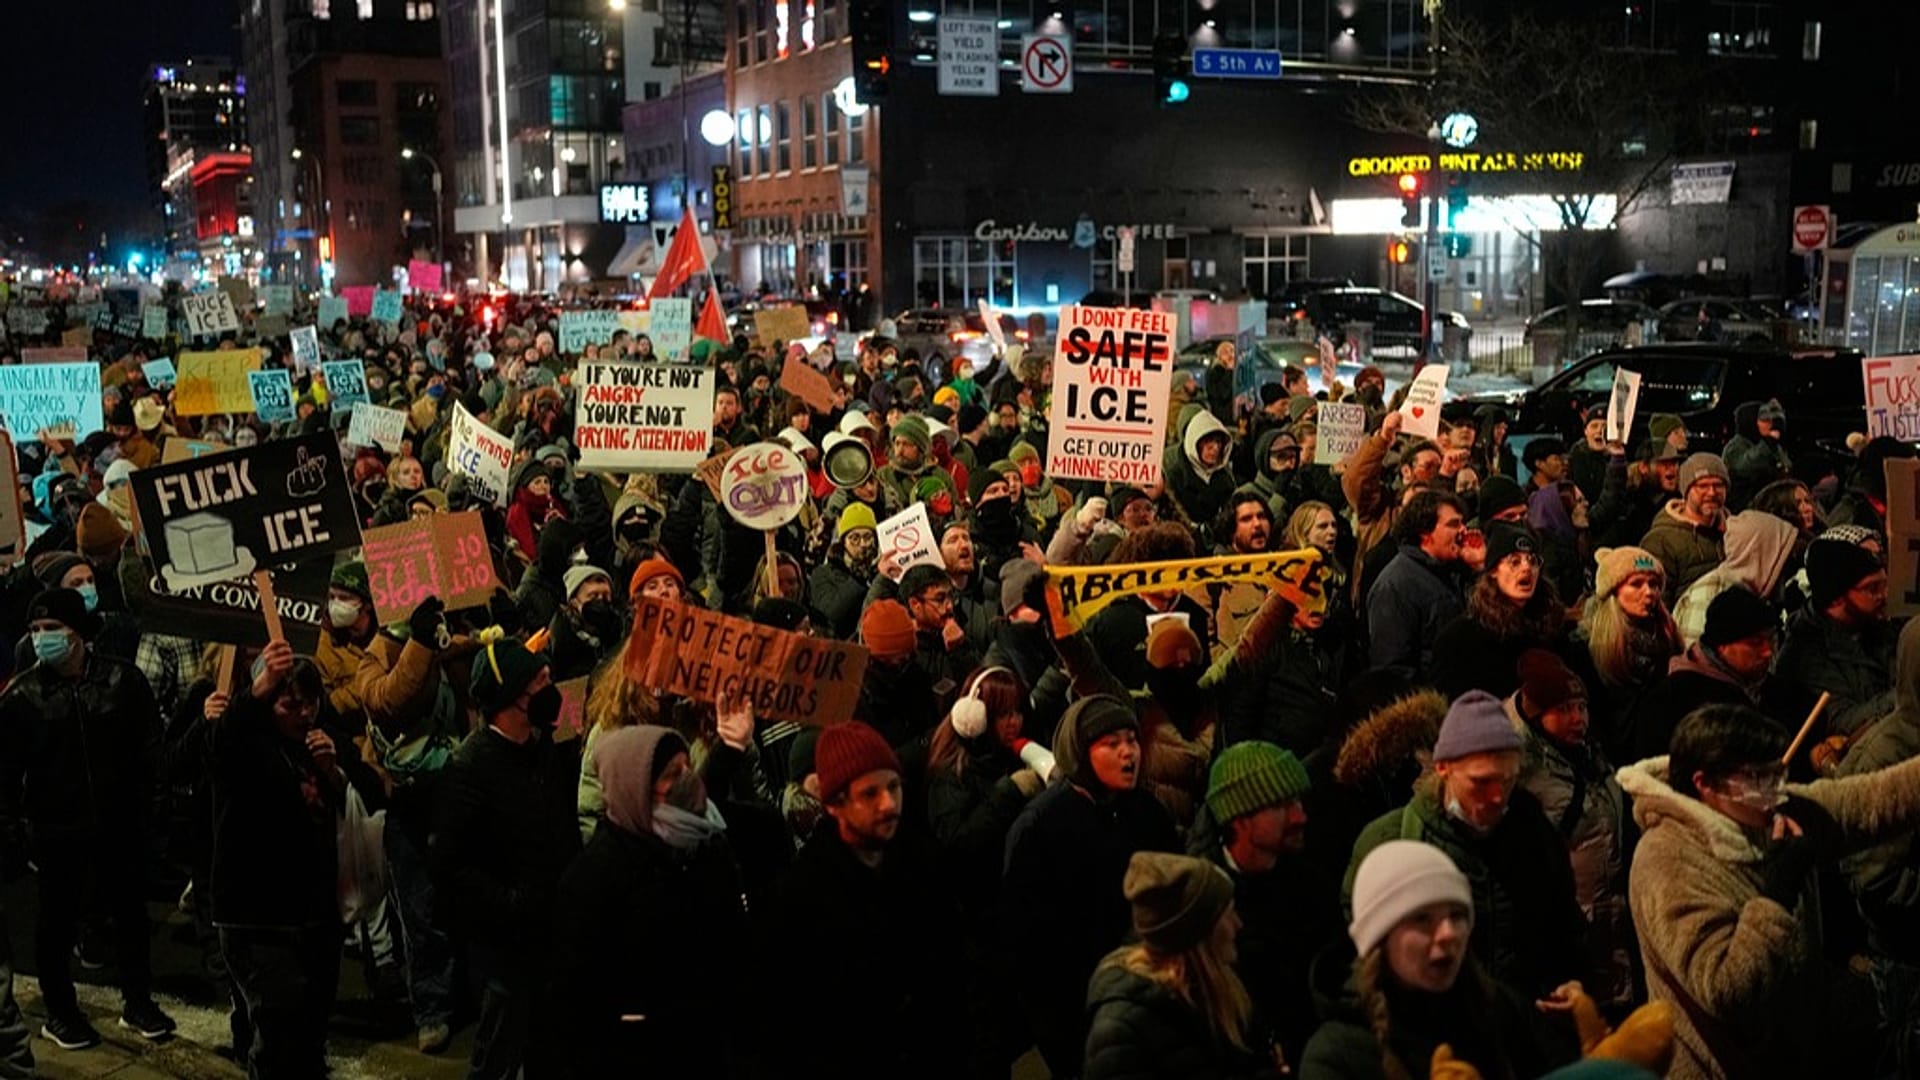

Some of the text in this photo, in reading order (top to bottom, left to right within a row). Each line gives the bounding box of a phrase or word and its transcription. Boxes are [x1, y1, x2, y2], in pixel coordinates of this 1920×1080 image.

[943, 23, 992, 33] LEFT TURN
[953, 38, 984, 48] YIELD
[956, 52, 994, 62] FLASHING
[1202, 55, 1273, 71] S 5th Av
[951, 65, 986, 75] YELLOW
[953, 78, 984, 87] ARROW
[1349, 155, 1431, 176] CROOKED
[1439, 153, 1480, 171] PINT
[715, 168, 729, 227] YOGA
[975, 219, 1069, 241] Caribou
[185, 294, 229, 314] FUCK
[196, 313, 228, 331] ICE
[1072, 308, 1170, 334] I DONT FEEL
[1066, 327, 1167, 372] SAFE
[586, 365, 704, 389] IF YOU'RE NOT
[1089, 367, 1142, 387] WITH
[75, 394, 86, 414] Y
[584, 385, 645, 403] ANGRY
[1067, 383, 1153, 425] I.C.E.
[646, 406, 686, 427] NOT
[476, 432, 513, 469] wrong
[576, 426, 706, 451] PAYING ATTENTION
[1063, 437, 1152, 461] GET OUT OF
[457, 442, 481, 475] ICE
[1051, 456, 1156, 483] MINNESOTA!
[154, 458, 258, 517] FUCK
[262, 503, 330, 554] ICE
[453, 534, 482, 565] OF
[451, 563, 490, 595] OUT
[211, 584, 322, 625] CONROL
[641, 603, 847, 681] PROTECT OUR
[672, 658, 819, 717] NEIGHBORS
